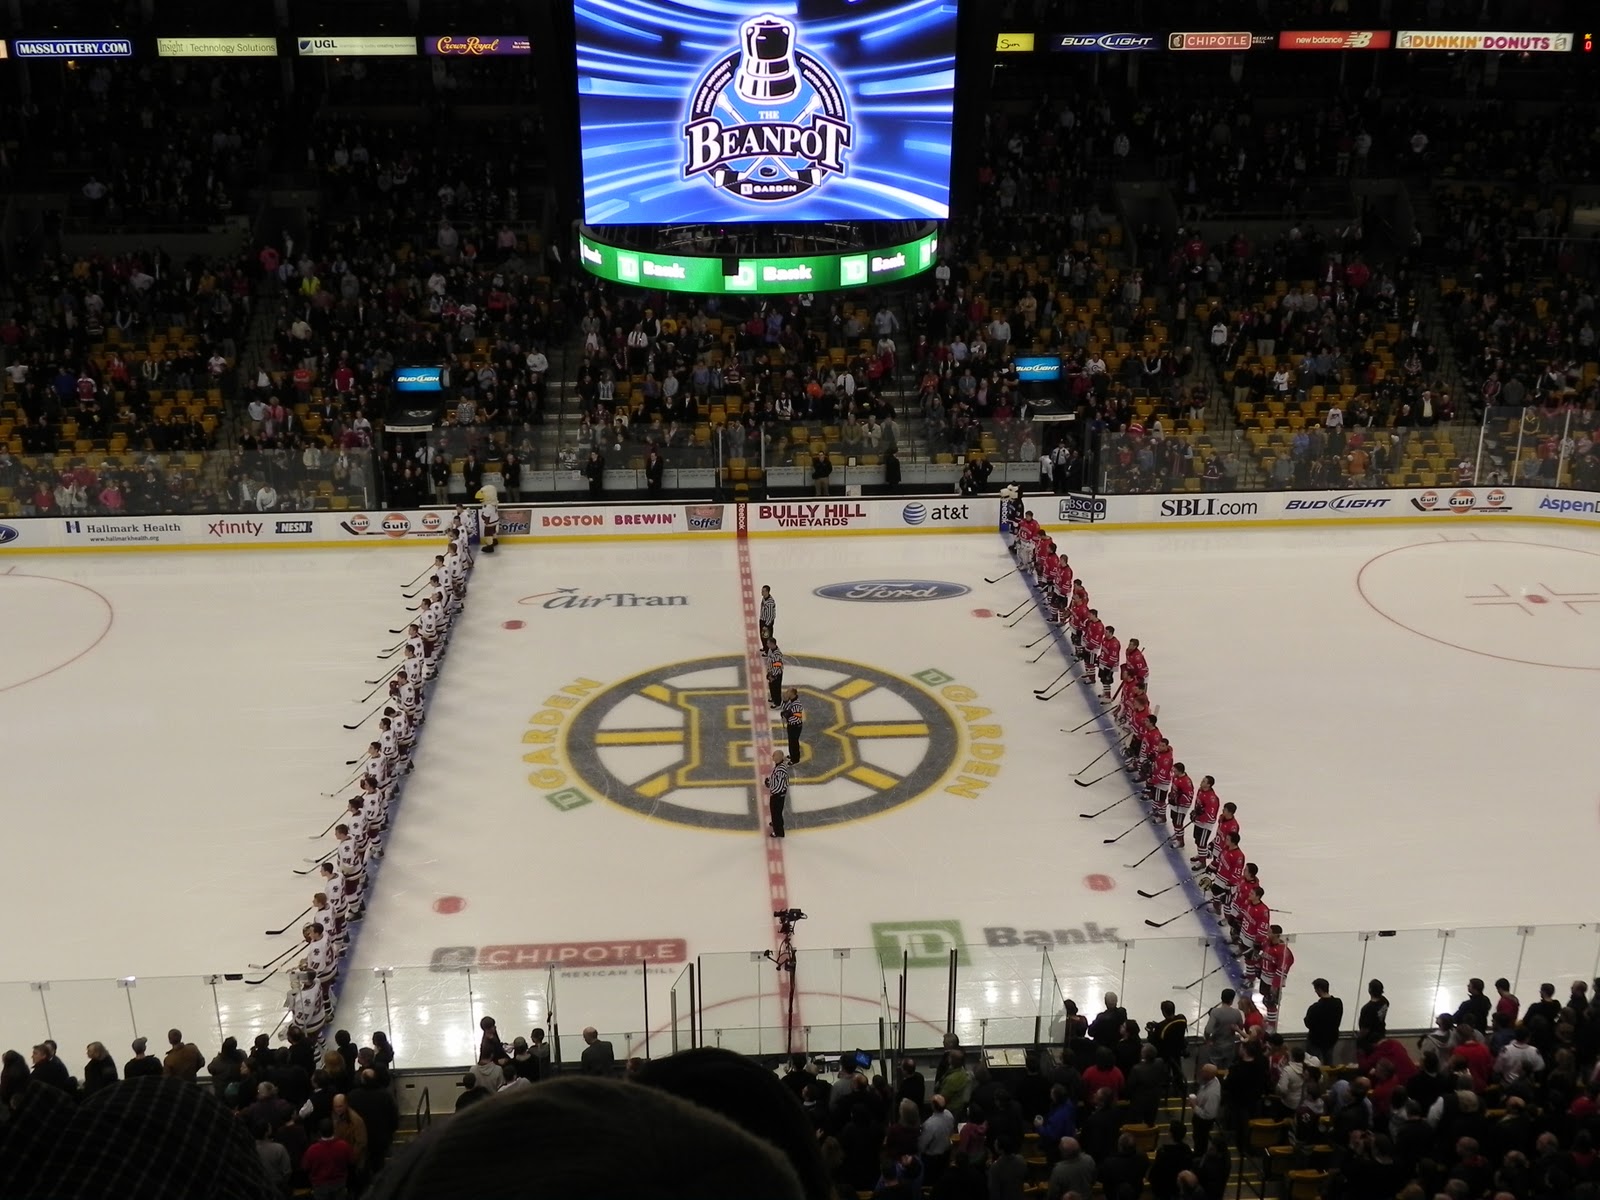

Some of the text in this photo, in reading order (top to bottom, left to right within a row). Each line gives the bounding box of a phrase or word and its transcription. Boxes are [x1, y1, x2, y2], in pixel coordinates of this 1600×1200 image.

[20, 43, 128, 54] MASSLOTTERY.COM
[160, 40, 276, 55] Insight Technology Solutions
[314, 40, 338, 48] UGL
[437, 36, 467, 54] Crown
[459, 36, 499, 55] Royal
[1061, 38, 1153, 46] BUD LIGHT
[1187, 36, 1247, 46] CHIPOTLE
[1412, 35, 1550, 49] DUNKIN' DONUTS
[758, 111, 779, 119] THE
[688, 118, 848, 172] BEANPOT
[754, 185, 797, 193] GARDEN
[642, 260, 686, 279] Bank
[871, 253, 906, 272] Bank
[763, 264, 813, 281] Bank
[759, 504, 866, 519] BULLY HILL
[931, 504, 969, 520] at&t
[1062, 499, 1104, 512] EBSCO
[1161, 498, 1258, 517] SBLI.com
[1285, 499, 1391, 510] BUD LIGHT
[542, 513, 677, 526] BOSTON BREWIN'
[738, 503, 746, 530] Reebok
[778, 518, 848, 527] VINEYARDS
[87, 523, 182, 534] Hallmark Health
[208, 520, 264, 537] xfinity
[281, 522, 307, 533] NESN
[382, 521, 409, 530] Gulf
[846, 583, 938, 599] Ford
[522, 677, 604, 790] GARDEN
[941, 684, 1005, 799] GARDEN
[983, 922, 1119, 947] Bank
[489, 943, 677, 965] CHIPOTLE
[561, 967, 676, 978] MEXICAN GRILL
